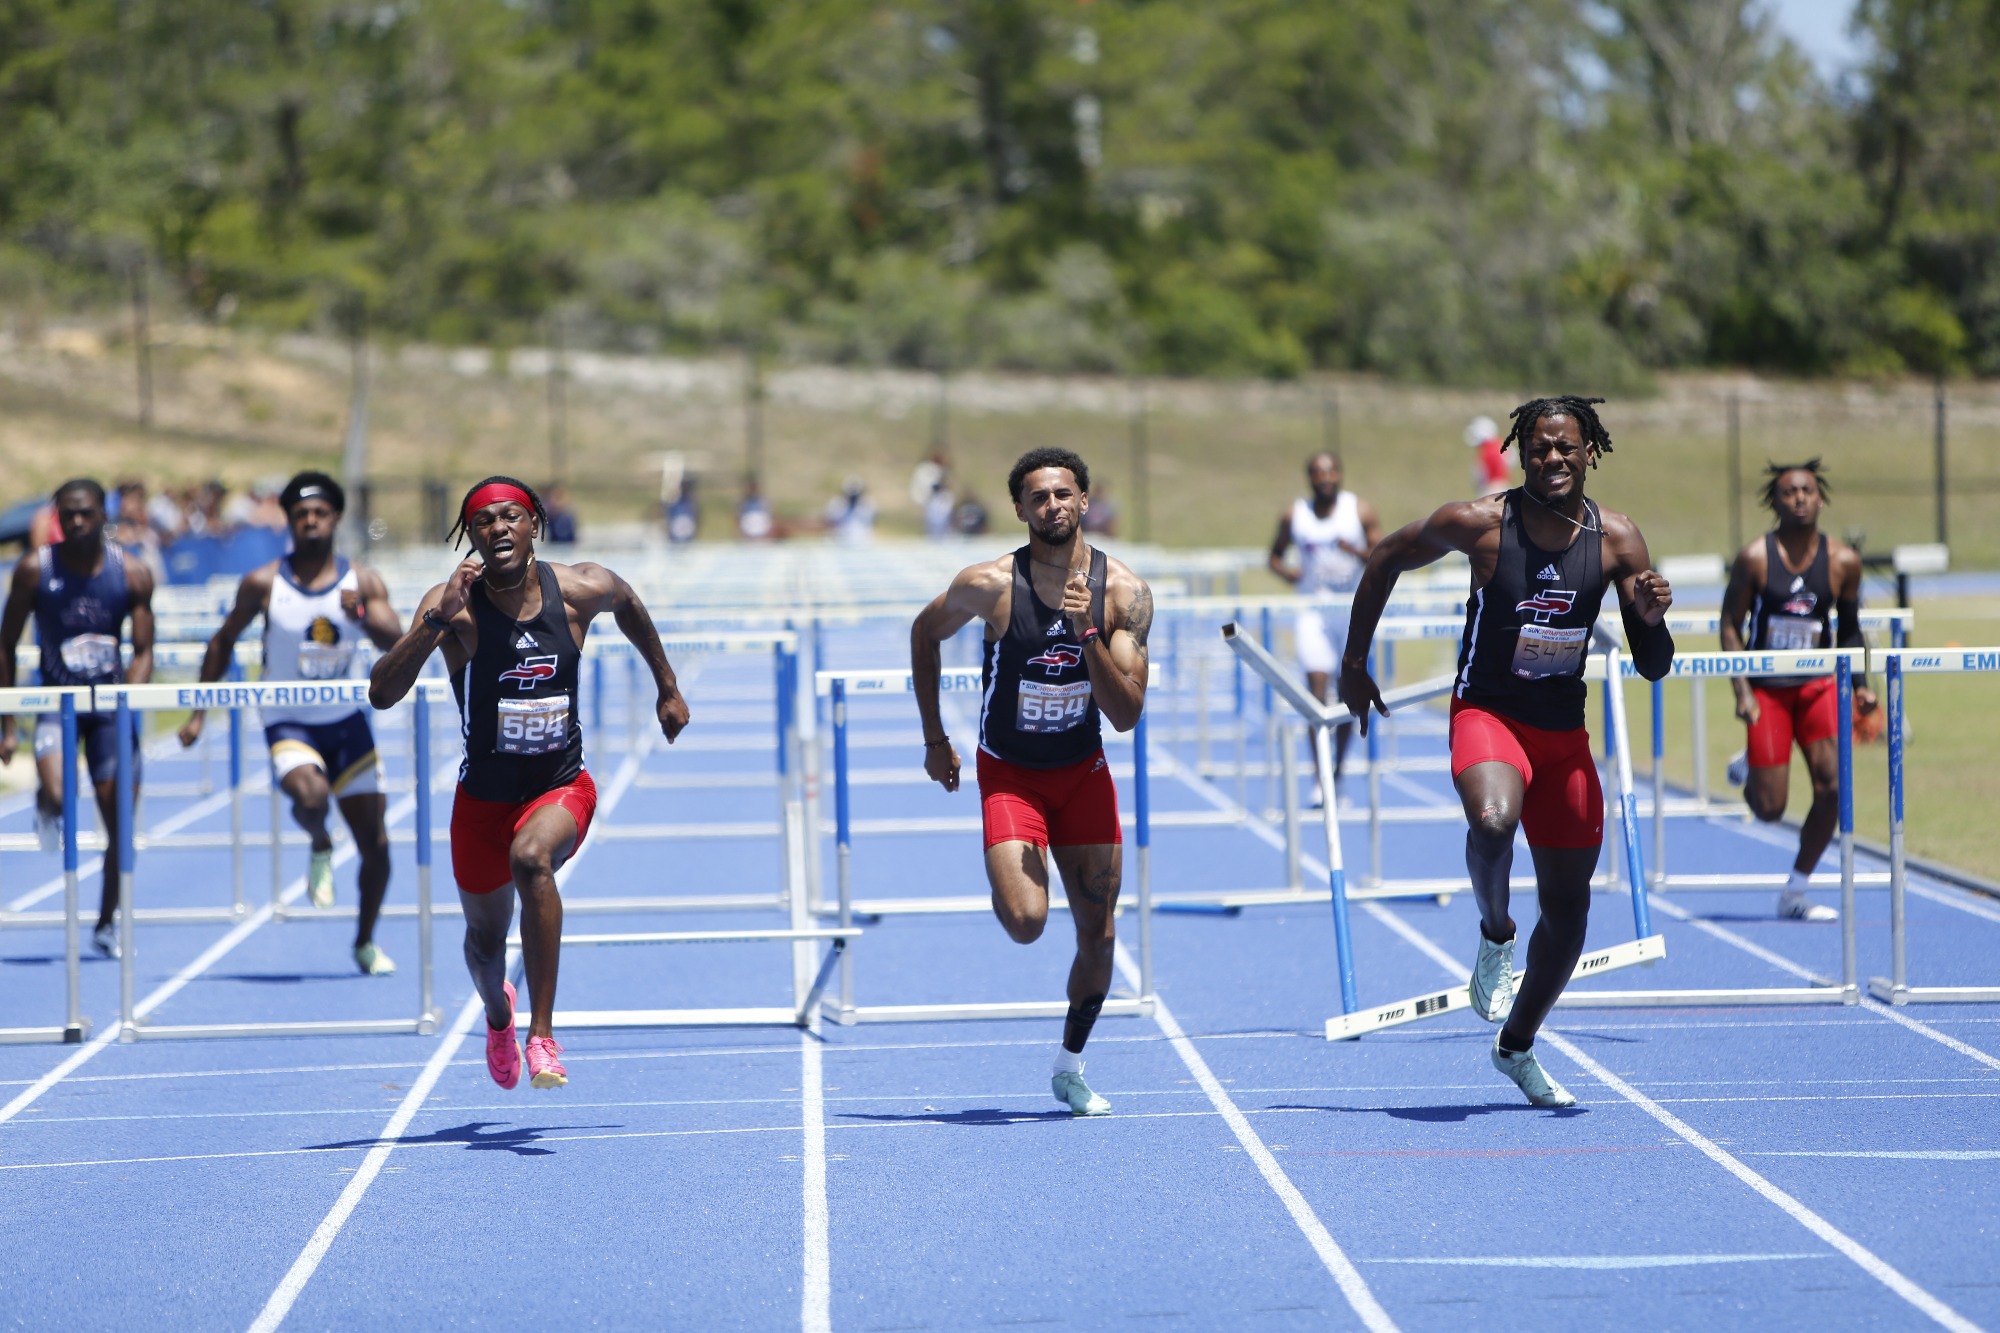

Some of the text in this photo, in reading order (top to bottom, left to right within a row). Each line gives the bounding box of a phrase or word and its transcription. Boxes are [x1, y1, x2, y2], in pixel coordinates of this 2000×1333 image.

[516, 641, 538, 649] adidas
[1522, 644, 1578, 664] 547
[1621, 656, 1825, 677] MY-RIDDLE GILL
[1912, 653, 2000, 671] GILL EM
[907, 675, 983, 691] EBRY
[178, 685, 366, 707] EMBRY-RIDDLE
[1022, 697, 1084, 721] 554
[503, 714, 564, 741] 524
